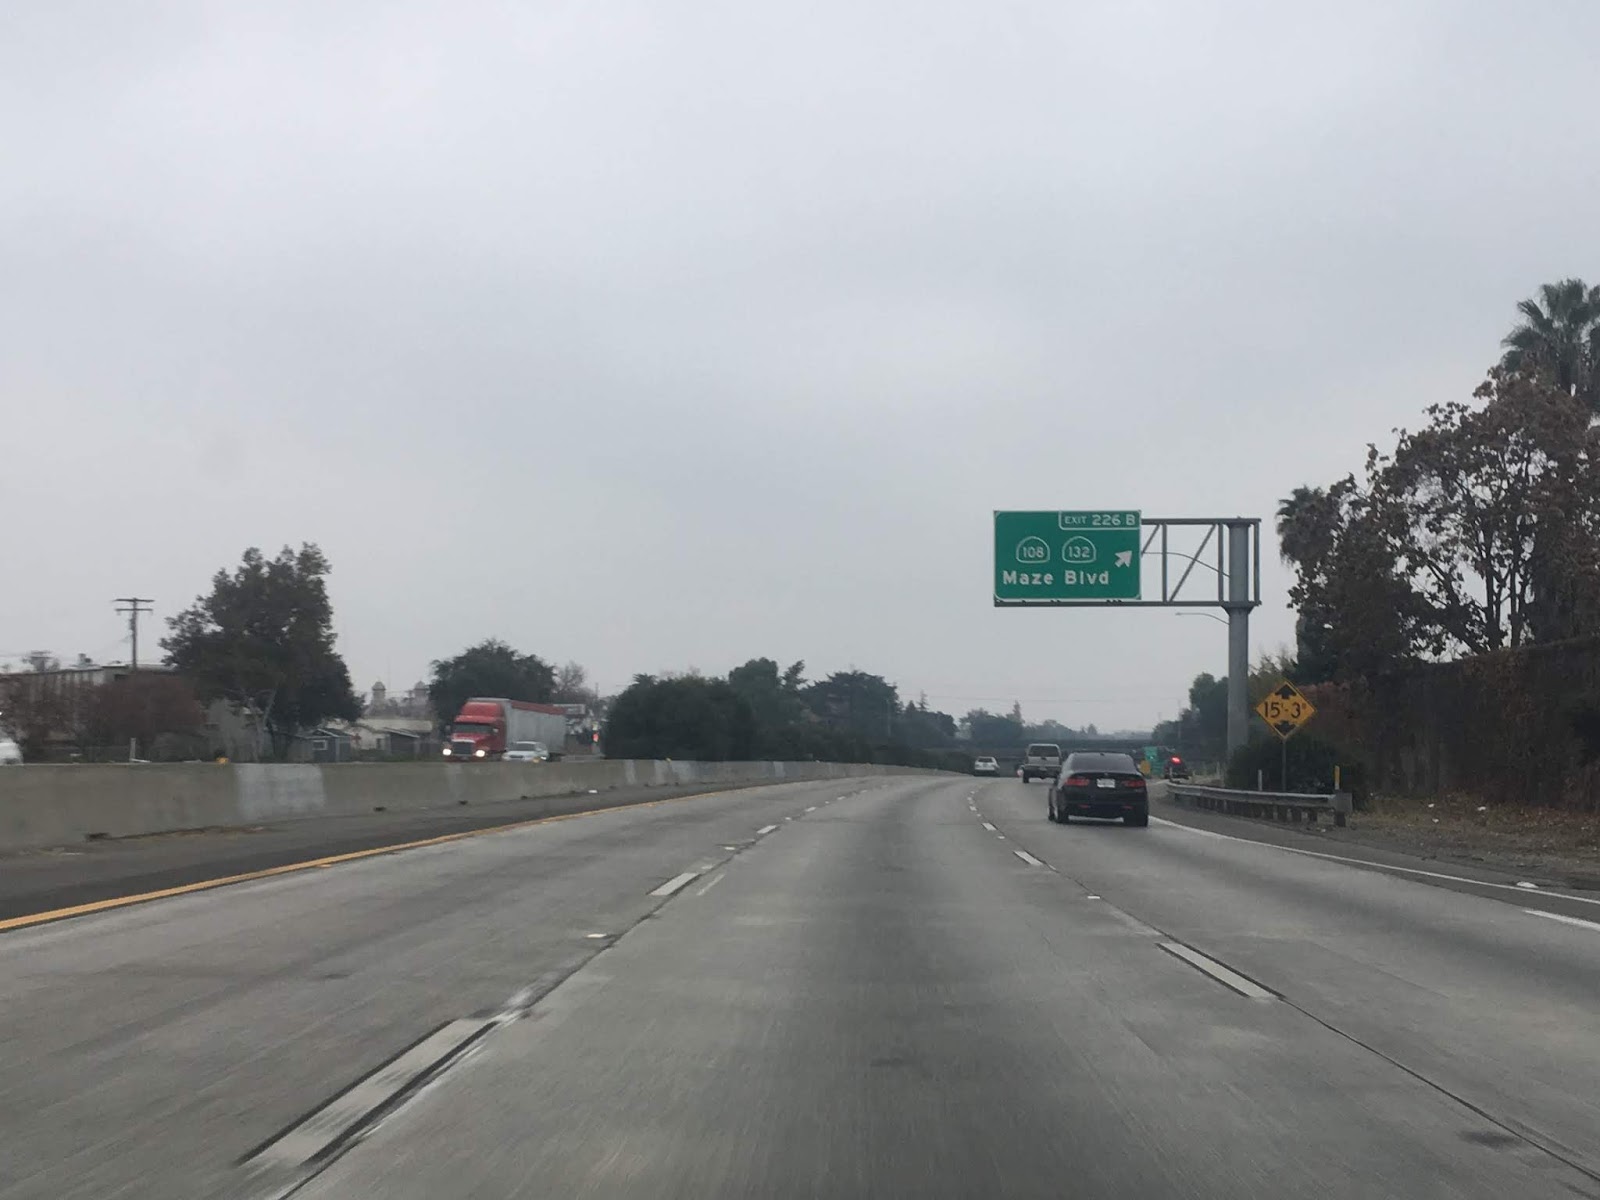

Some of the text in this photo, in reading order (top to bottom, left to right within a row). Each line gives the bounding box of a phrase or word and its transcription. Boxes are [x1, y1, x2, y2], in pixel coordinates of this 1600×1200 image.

[1064, 513, 1136, 526] EXIT 226 B
[1022, 545, 1045, 558] 108
[1068, 545, 1091, 558] 132
[1002, 569, 1109, 585] Maze Blvd
